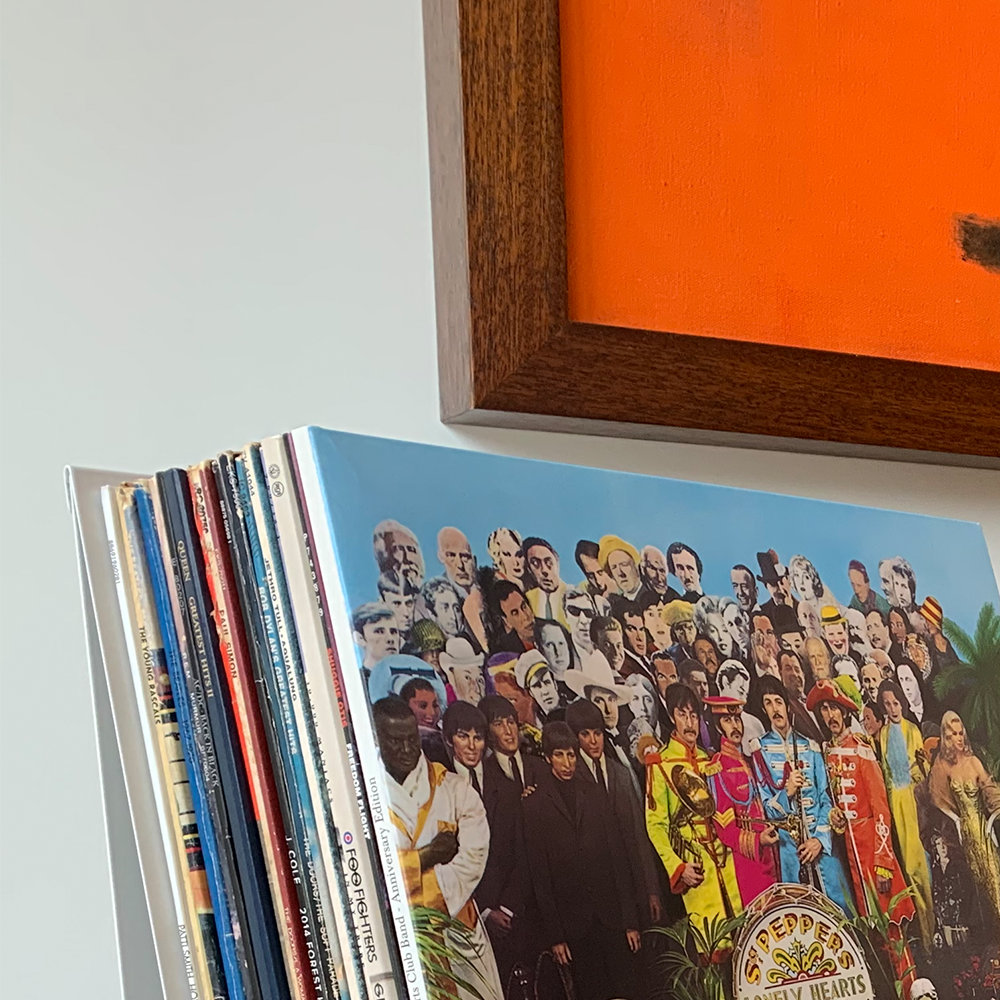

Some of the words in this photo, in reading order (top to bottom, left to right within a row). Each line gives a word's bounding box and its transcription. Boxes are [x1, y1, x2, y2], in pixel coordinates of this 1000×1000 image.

[177, 539, 191, 582] QUEEN
[137, 626, 147, 643] THE
[187, 595, 206, 655] GREATEST
[218, 609, 229, 636] PAUL
[225, 641, 237, 679] SIMON
[264, 558, 276, 601] JETHRO
[273, 603, 282, 629] TULL
[281, 640, 297, 702] AQUALUNG
[141, 645, 154, 681] YOUNG
[199, 657, 212, 686] HITS
[257, 585, 269, 611] BOB
[263, 614, 279, 663] DYLAN'S
[274, 665, 291, 726] GREATEST
[285, 728, 298, 755] HITS
[148, 683, 162, 725] RASCALS
[189, 691, 202, 734] MURMUR
[191, 677, 204, 709] AC/DC
[205, 687, 214, 698] II
[198, 714, 210, 742] BACK
[203, 741, 213, 753] IN
[326, 646, 341, 698] SHUGGIE
[336, 700, 348, 728] OTIS
[345, 742, 361, 797] FREEDOM
[357, 798, 370, 840] FLIGHT
[206, 755, 218, 787] BLACK
[366, 776, 384, 823] Edition
[345, 847, 362, 887] FOO
[376, 825, 401, 904] Anniversary
[287, 849, 300, 885] COLE
[298, 906, 311, 936] 2014
[305, 941, 322, 992] FOREST
[353, 888, 377, 963] FIGHTERS
[396, 915, 410, 948] Band
[756, 913, 855, 969] PEPPERS
[404, 951, 417, 983] Club
